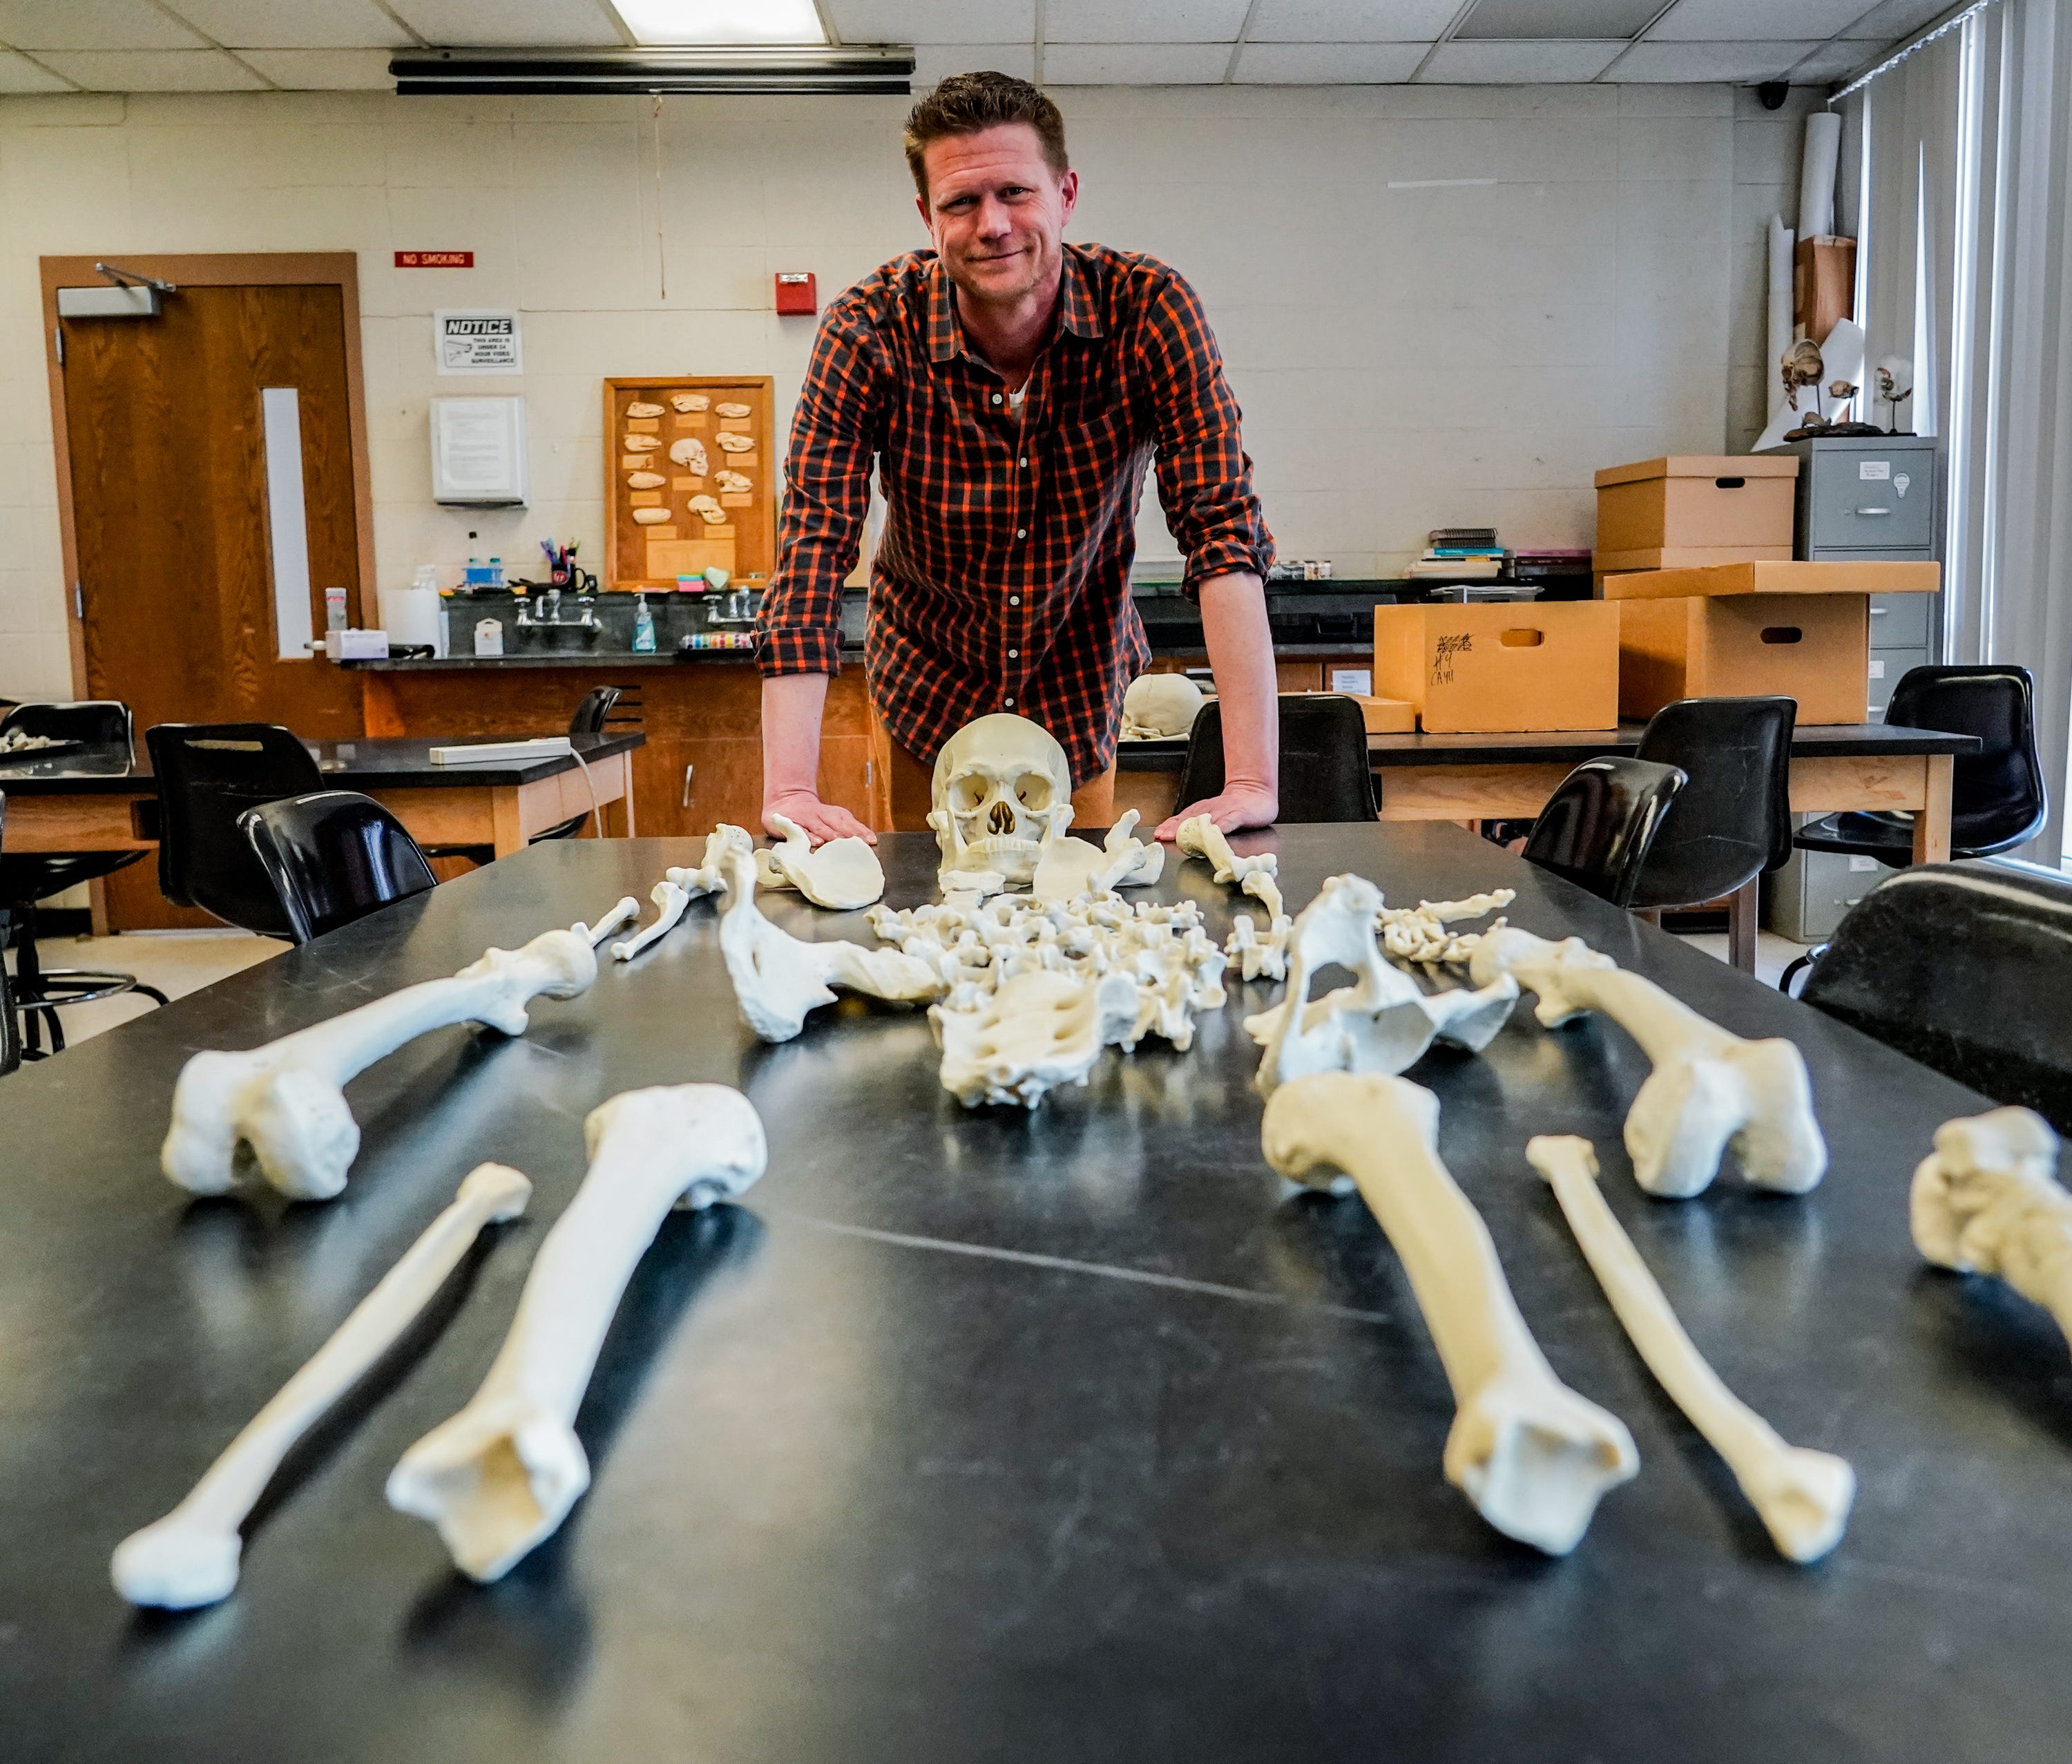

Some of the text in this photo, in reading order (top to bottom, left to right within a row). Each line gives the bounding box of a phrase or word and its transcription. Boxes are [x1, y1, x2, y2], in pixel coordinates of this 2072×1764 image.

[403, 253, 465, 265] NO SMOKING
[447, 320, 510, 334] NOTICE
